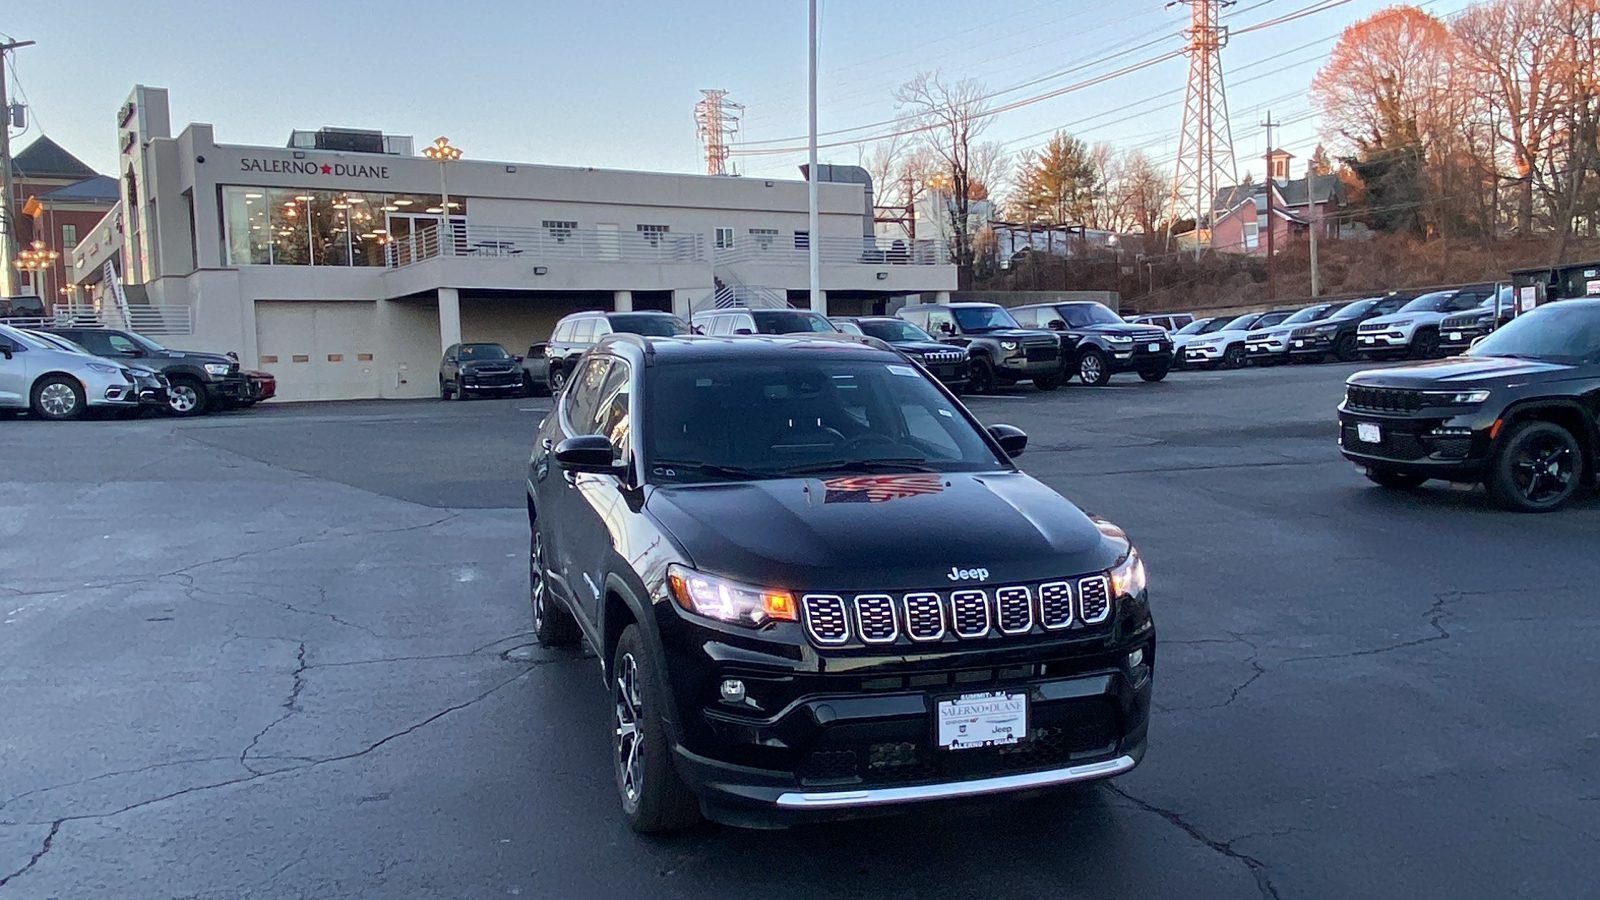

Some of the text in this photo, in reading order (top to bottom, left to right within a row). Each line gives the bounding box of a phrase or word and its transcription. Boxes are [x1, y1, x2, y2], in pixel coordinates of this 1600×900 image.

[240, 158, 390, 179] SALERNO DUANE
[947, 566, 989, 581] Jeep
[941, 704, 985, 717] SALERNO
[992, 726, 1012, 734] Jeep
